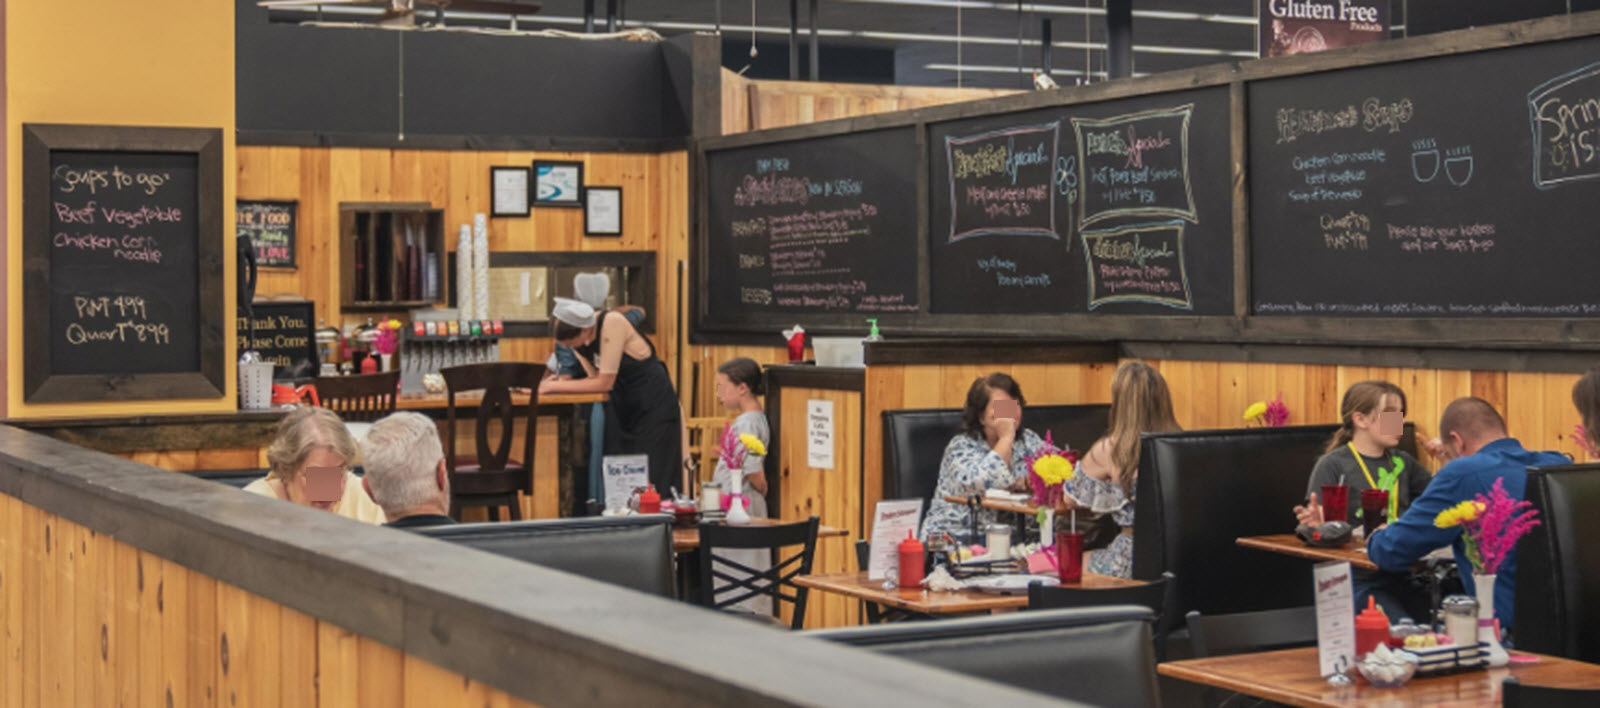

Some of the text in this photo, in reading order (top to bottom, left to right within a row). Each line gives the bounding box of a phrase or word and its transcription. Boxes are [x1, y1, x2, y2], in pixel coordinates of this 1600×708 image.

[1269, 0, 1378, 22] Gluten Free
[1538, 97, 1600, 142] Sprin
[1570, 130, 1596, 169] is
[52, 164, 109, 194] Soups
[112, 165, 133, 190] to
[53, 201, 182, 229] Beef Vegetable
[53, 232, 119, 250] Chicken
[113, 247, 162, 263] noodle
[259, 246, 290, 259] LOVE
[237, 334, 309, 350] Plase Come
